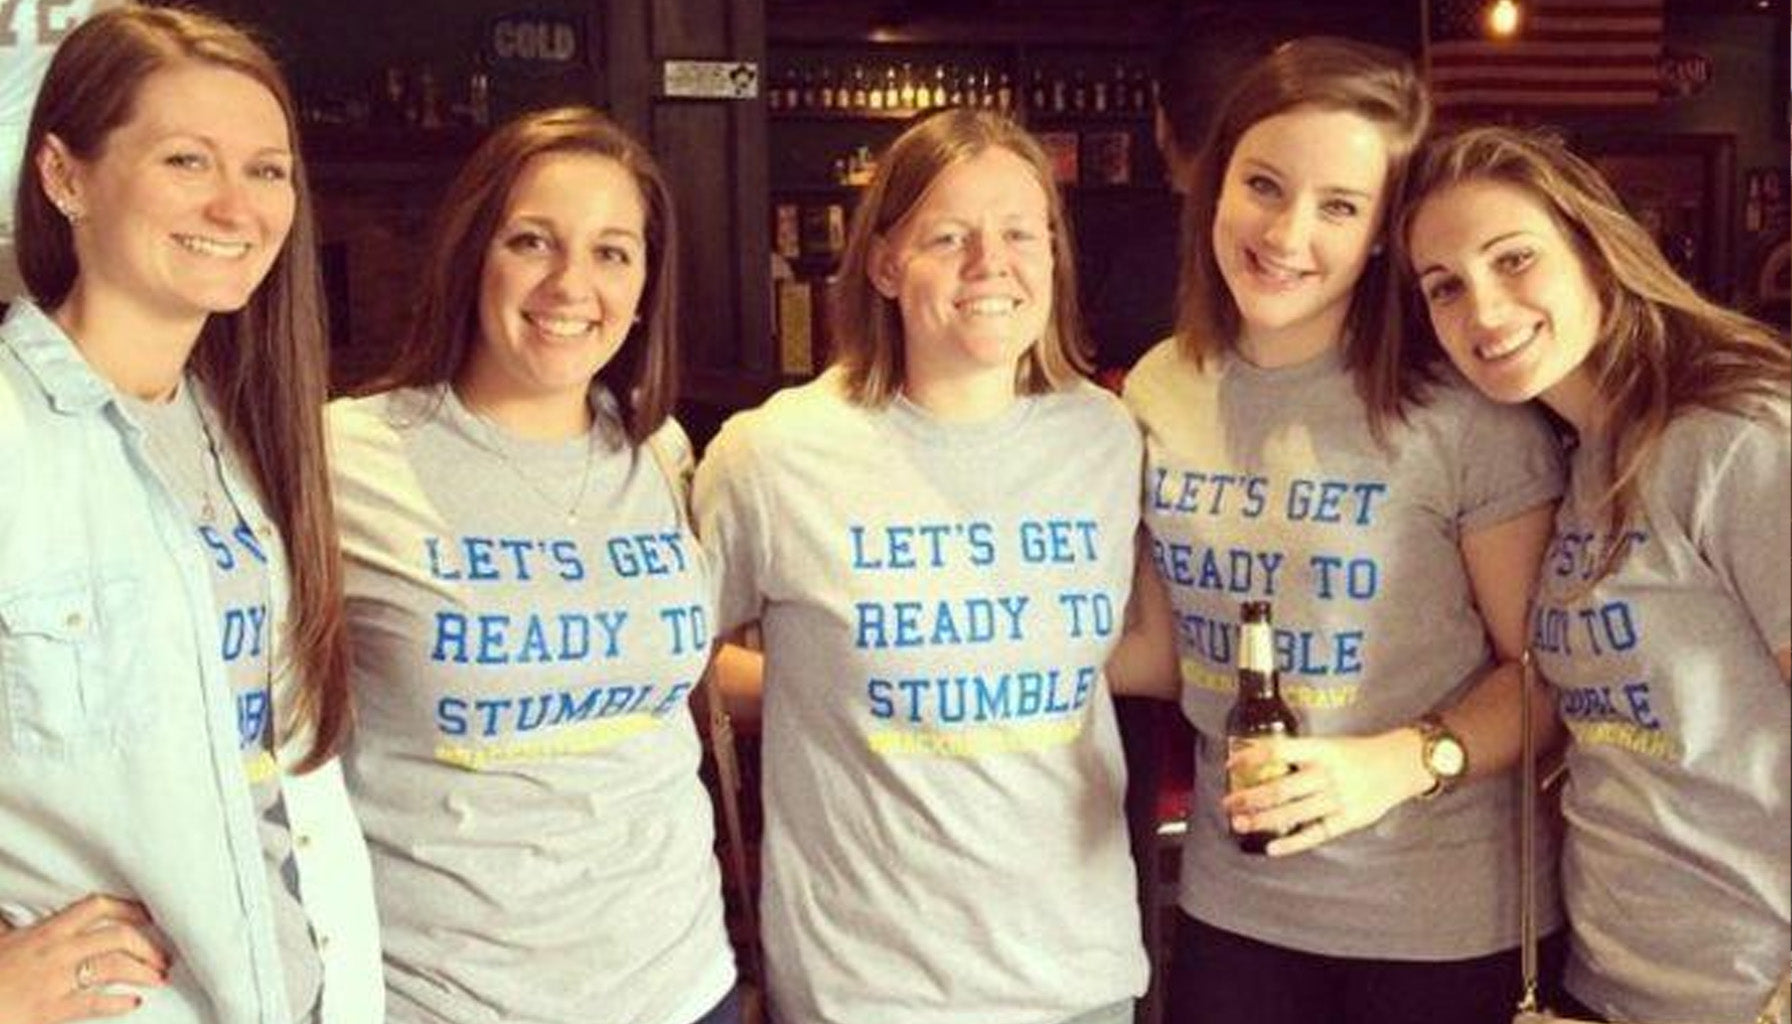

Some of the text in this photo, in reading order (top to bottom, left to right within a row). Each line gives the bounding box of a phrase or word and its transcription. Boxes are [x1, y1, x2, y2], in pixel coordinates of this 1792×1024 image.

[495, 20, 575, 60] COLD
[1153, 467, 1386, 526] LET'S GET
[424, 532, 685, 581] LET'S GET
[850, 520, 1098, 569] LET'S GET
[1310, 556, 1378, 600] TO
[431, 605, 706, 664] READY TO
[856, 593, 1113, 648] READY TO
[1579, 602, 1636, 656] TO
[867, 666, 1095, 723] STUMBLE
